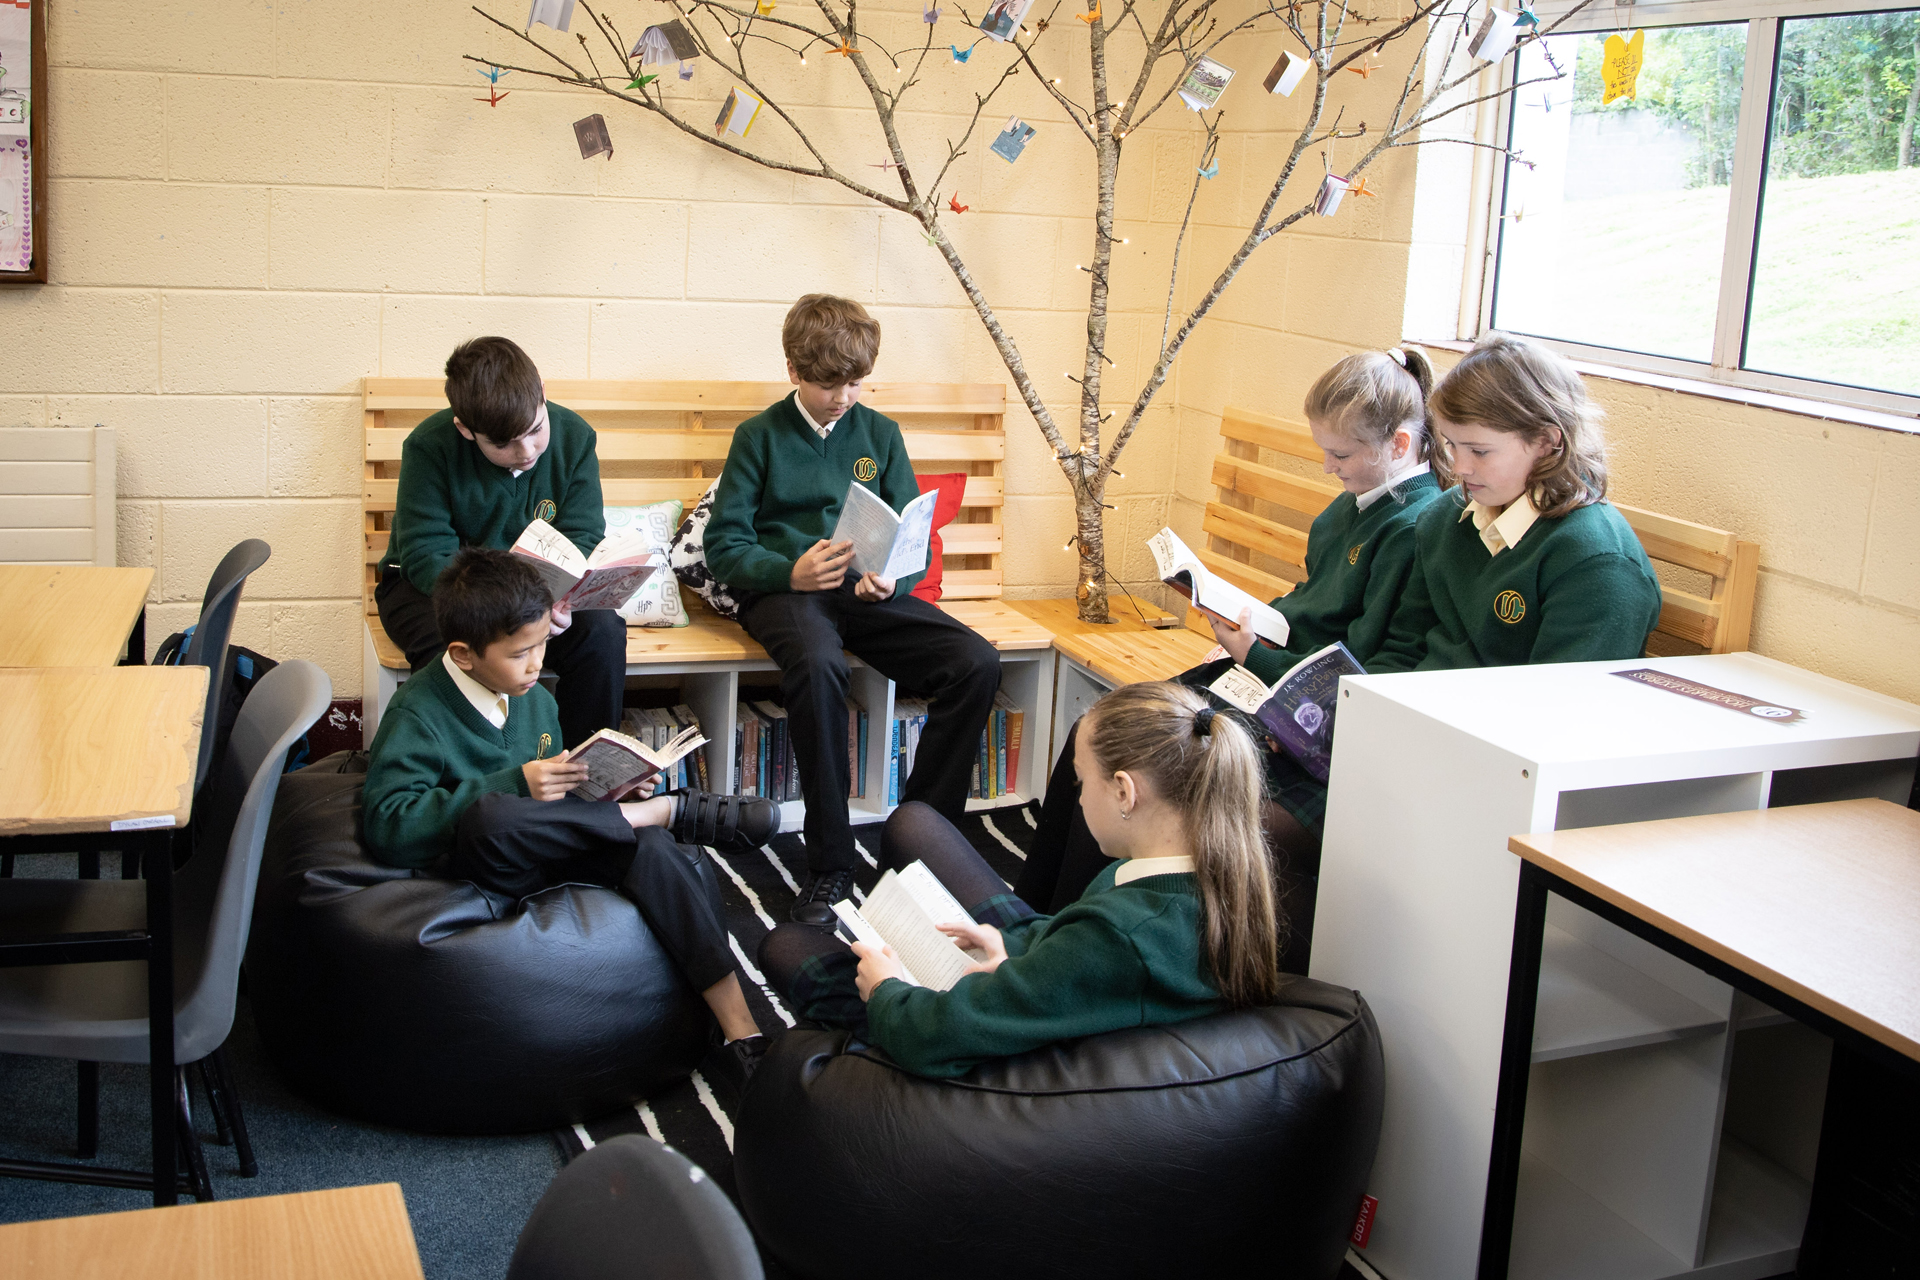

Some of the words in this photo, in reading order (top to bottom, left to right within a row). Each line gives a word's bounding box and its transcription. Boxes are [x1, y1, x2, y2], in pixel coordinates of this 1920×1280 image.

[1295, 656, 1334, 683] ROWLING
[1284, 681, 1319, 712] HARRY
[1313, 661, 1353, 688] POTTER
[1011, 727, 1021, 750] MALALA
[791, 767, 799, 793] Dickens
[1353, 1198, 1371, 1242] KAIKOO
